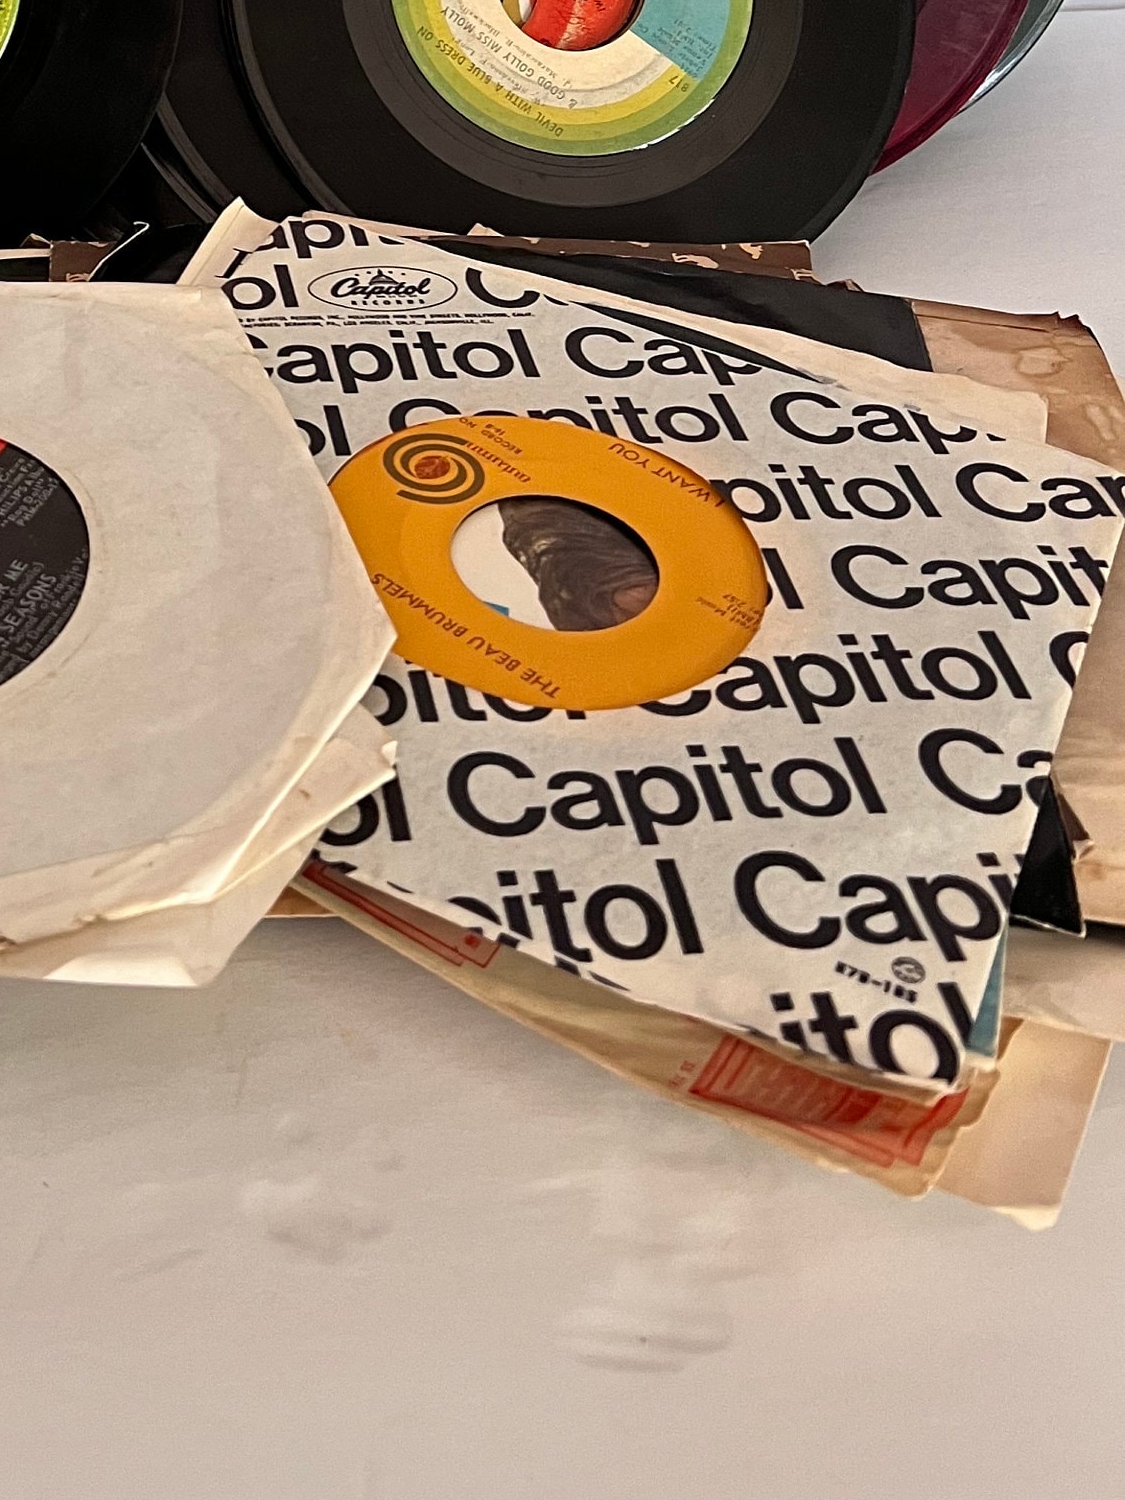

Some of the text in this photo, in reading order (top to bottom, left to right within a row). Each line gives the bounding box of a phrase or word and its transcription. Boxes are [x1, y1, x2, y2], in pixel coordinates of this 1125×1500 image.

[439, 4, 476, 34] MOLLY
[474, 30, 502, 53] MISS
[500, 49, 535, 79] GOLLY
[415, 25, 564, 137] DEVIL WITH A BLUE DRESS ON
[534, 74, 566, 101] GOOD
[330, 276, 431, 299] Capitol
[608, 441, 652, 472] YOU
[654, 463, 713, 504] WANT
[3, 555, 29, 582] ME
[372, 572, 561, 700] THE BEAU BRUMMELS
[447, 736, 887, 846] Capitol
